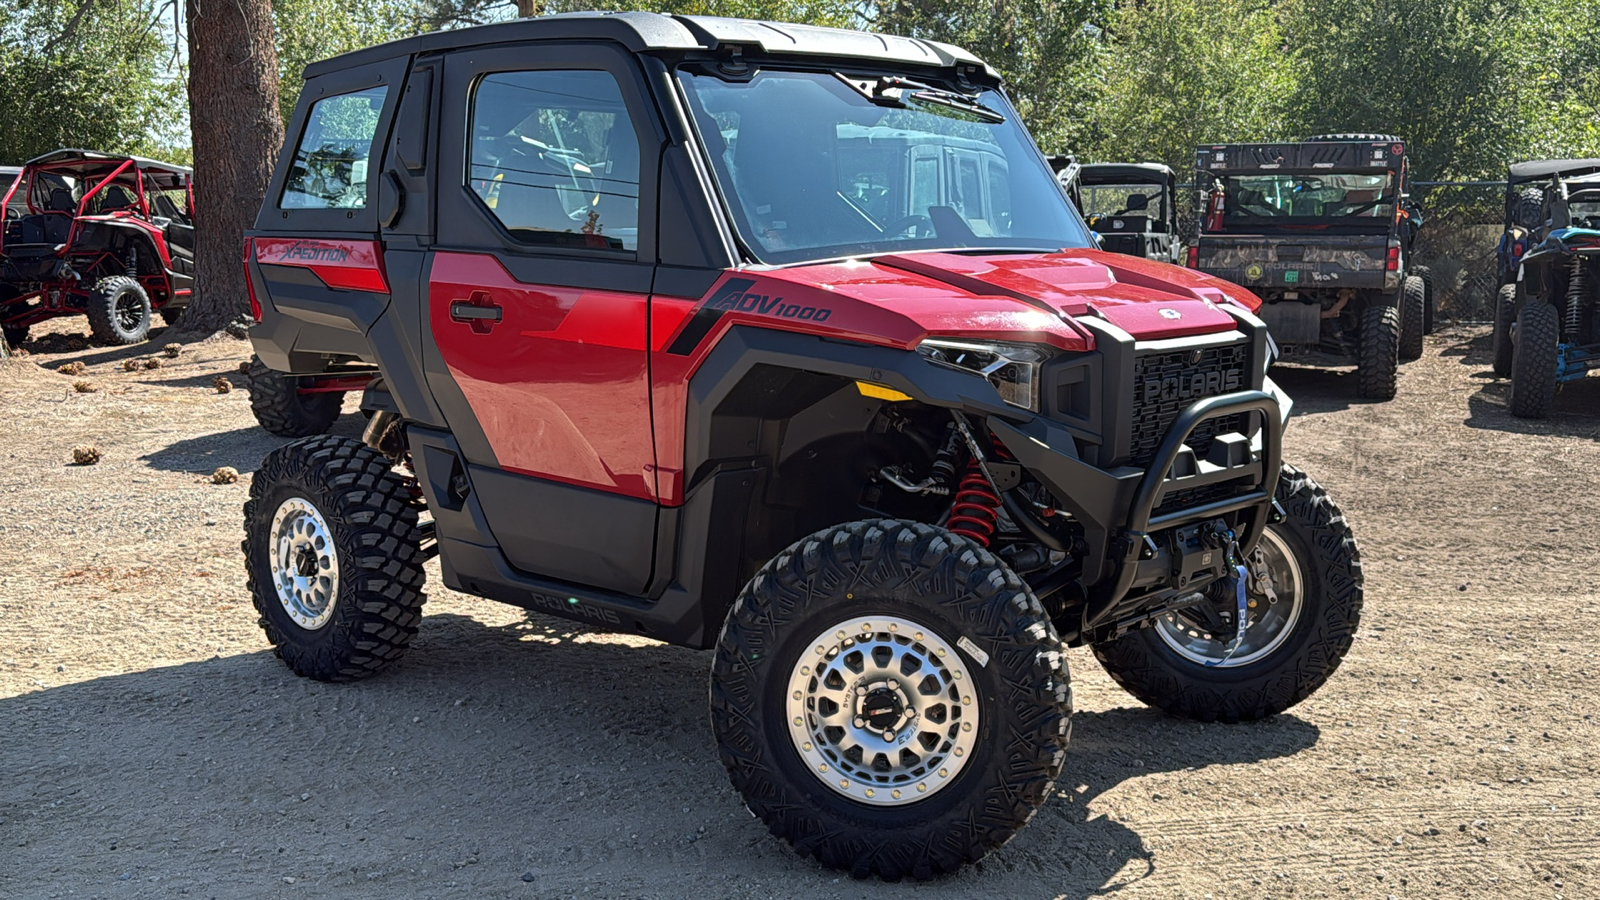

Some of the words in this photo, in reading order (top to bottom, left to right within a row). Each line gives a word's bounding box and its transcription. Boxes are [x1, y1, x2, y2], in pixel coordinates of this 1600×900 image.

[279, 240, 349, 262] XPEDITION
[1144, 368, 1240, 402] POLARIS
[531, 592, 620, 624] POLARIS
